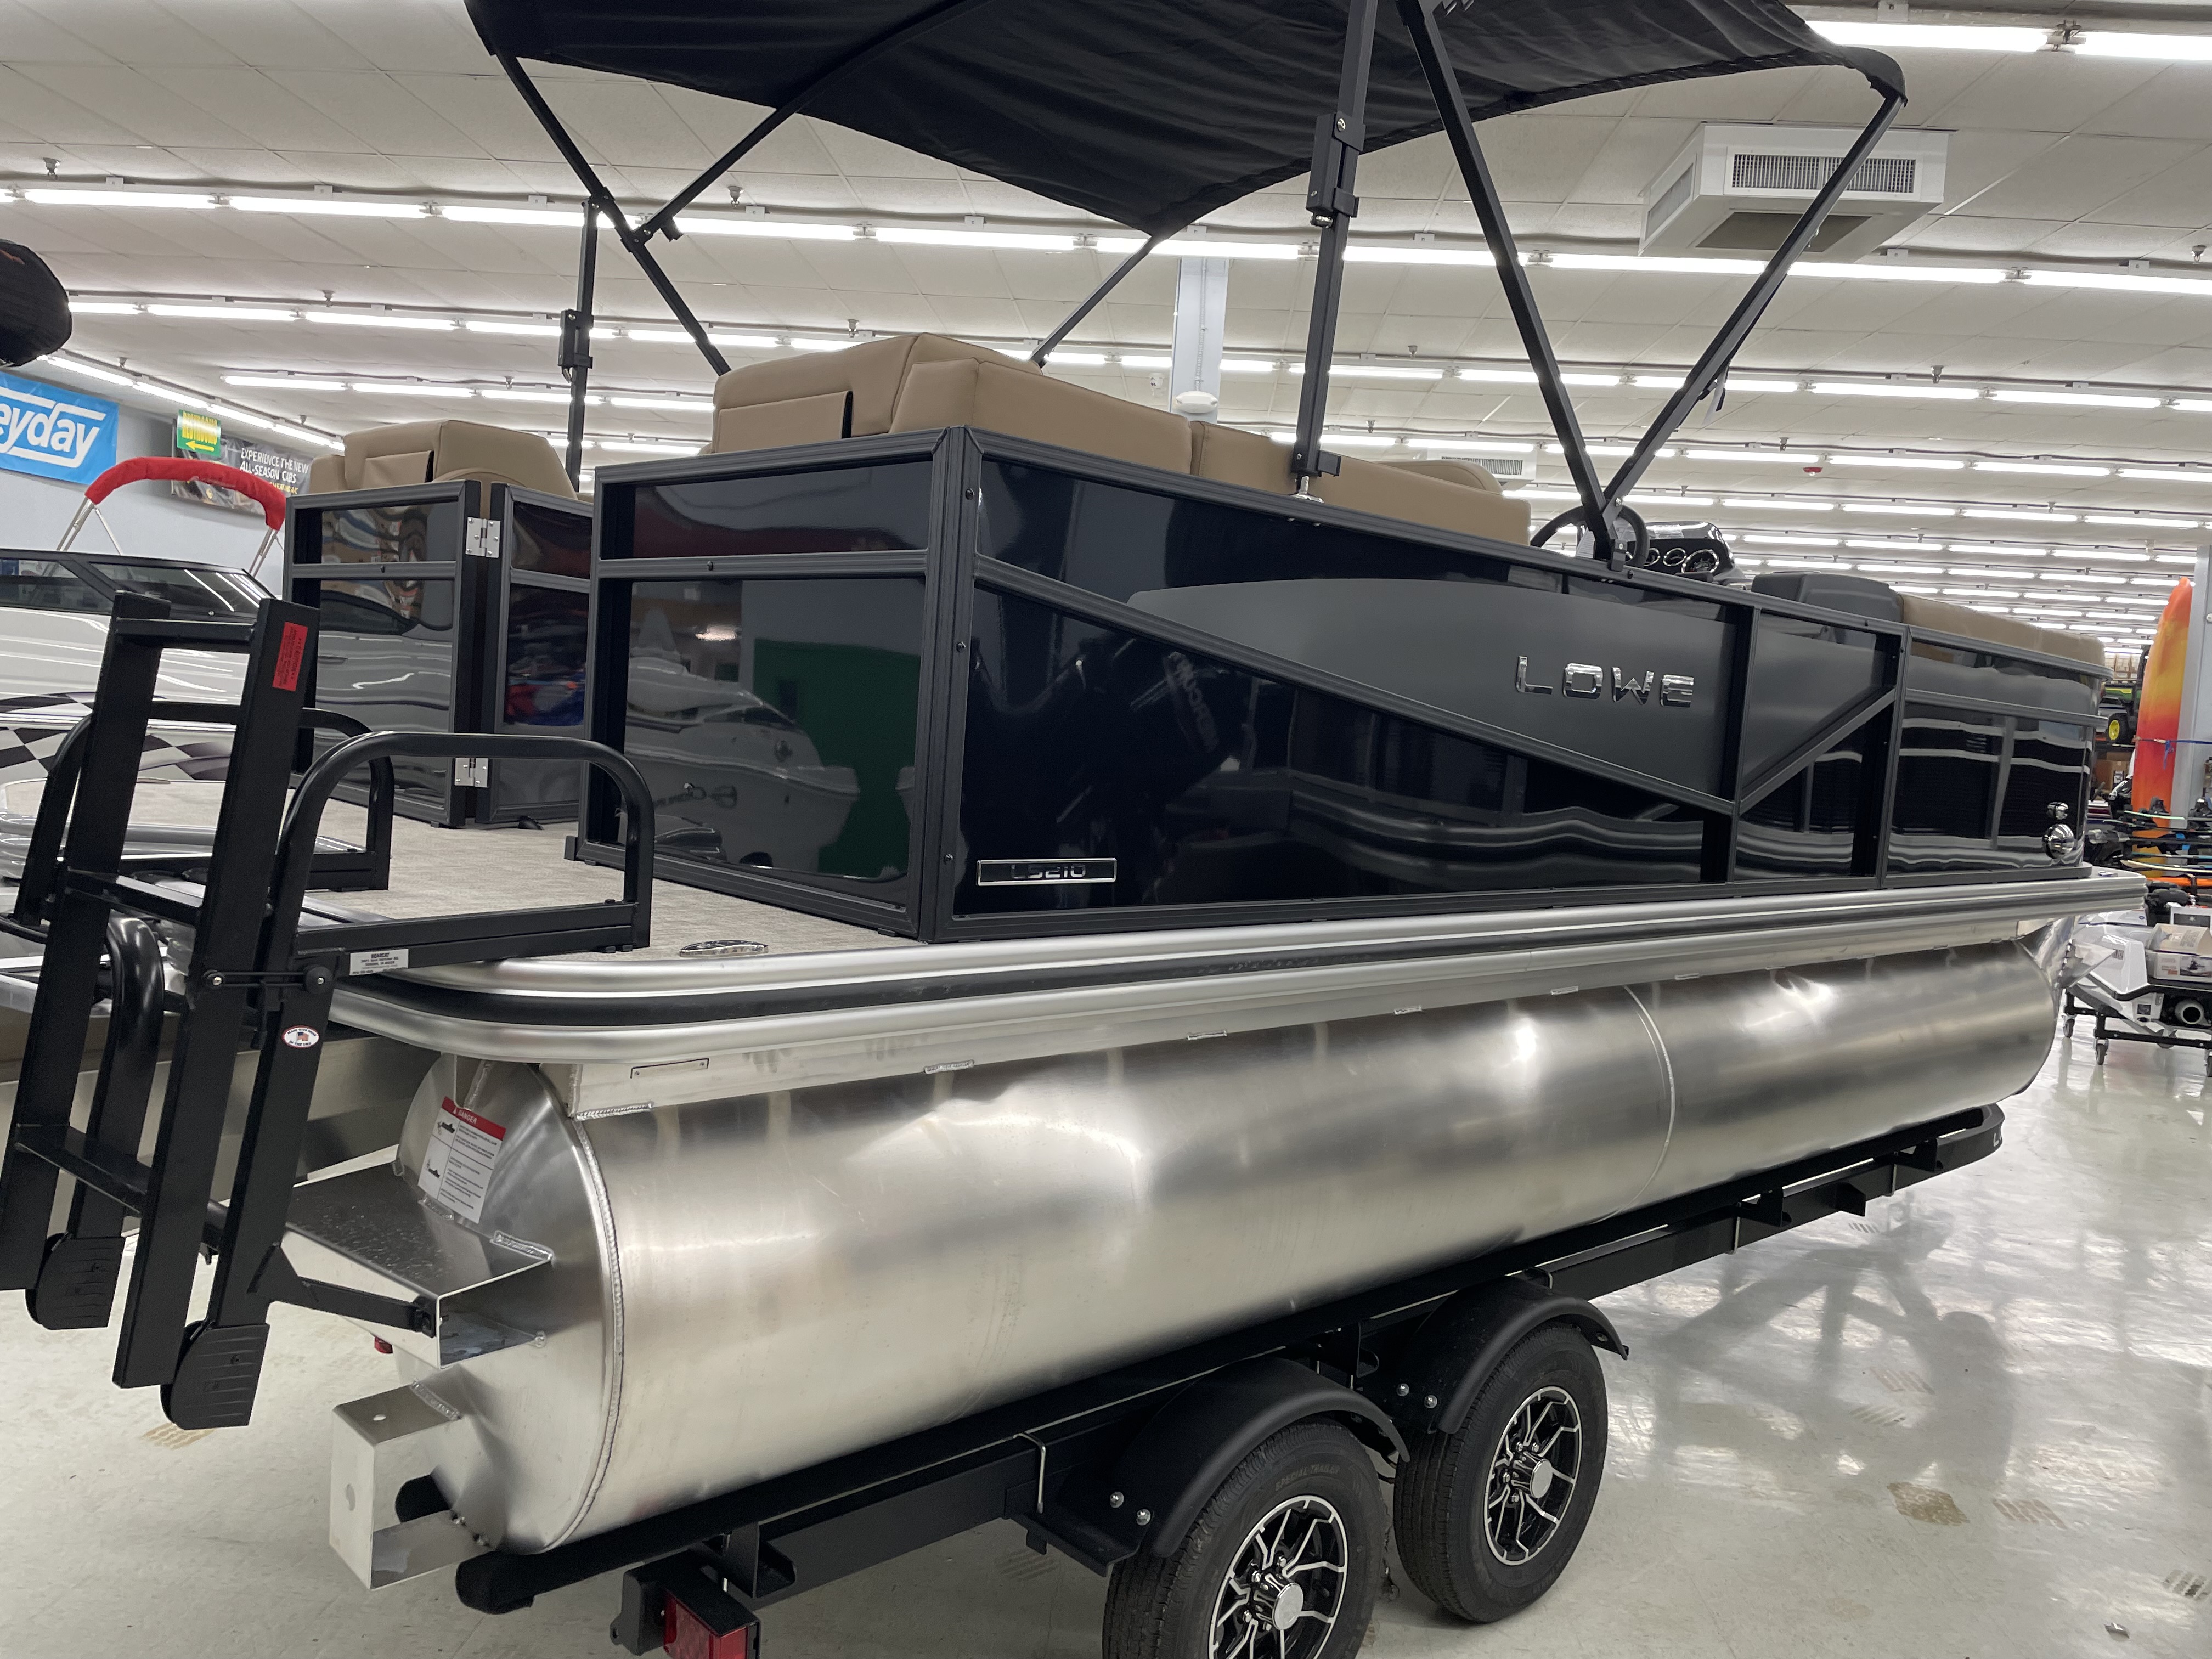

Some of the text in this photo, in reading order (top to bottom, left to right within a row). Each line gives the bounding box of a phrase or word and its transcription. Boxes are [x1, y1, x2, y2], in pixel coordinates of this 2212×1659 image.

[239, 460, 297, 484] ALL-SEASON CABS
[241, 448, 309, 474] EXPERIENCE THE NEW
[1516, 655, 1695, 708] LOWE
[1011, 864, 1086, 879] LS210
[458, 1109, 478, 1125] DANGER
[1276, 1464, 1340, 1492] SPECIAL TRAILER
